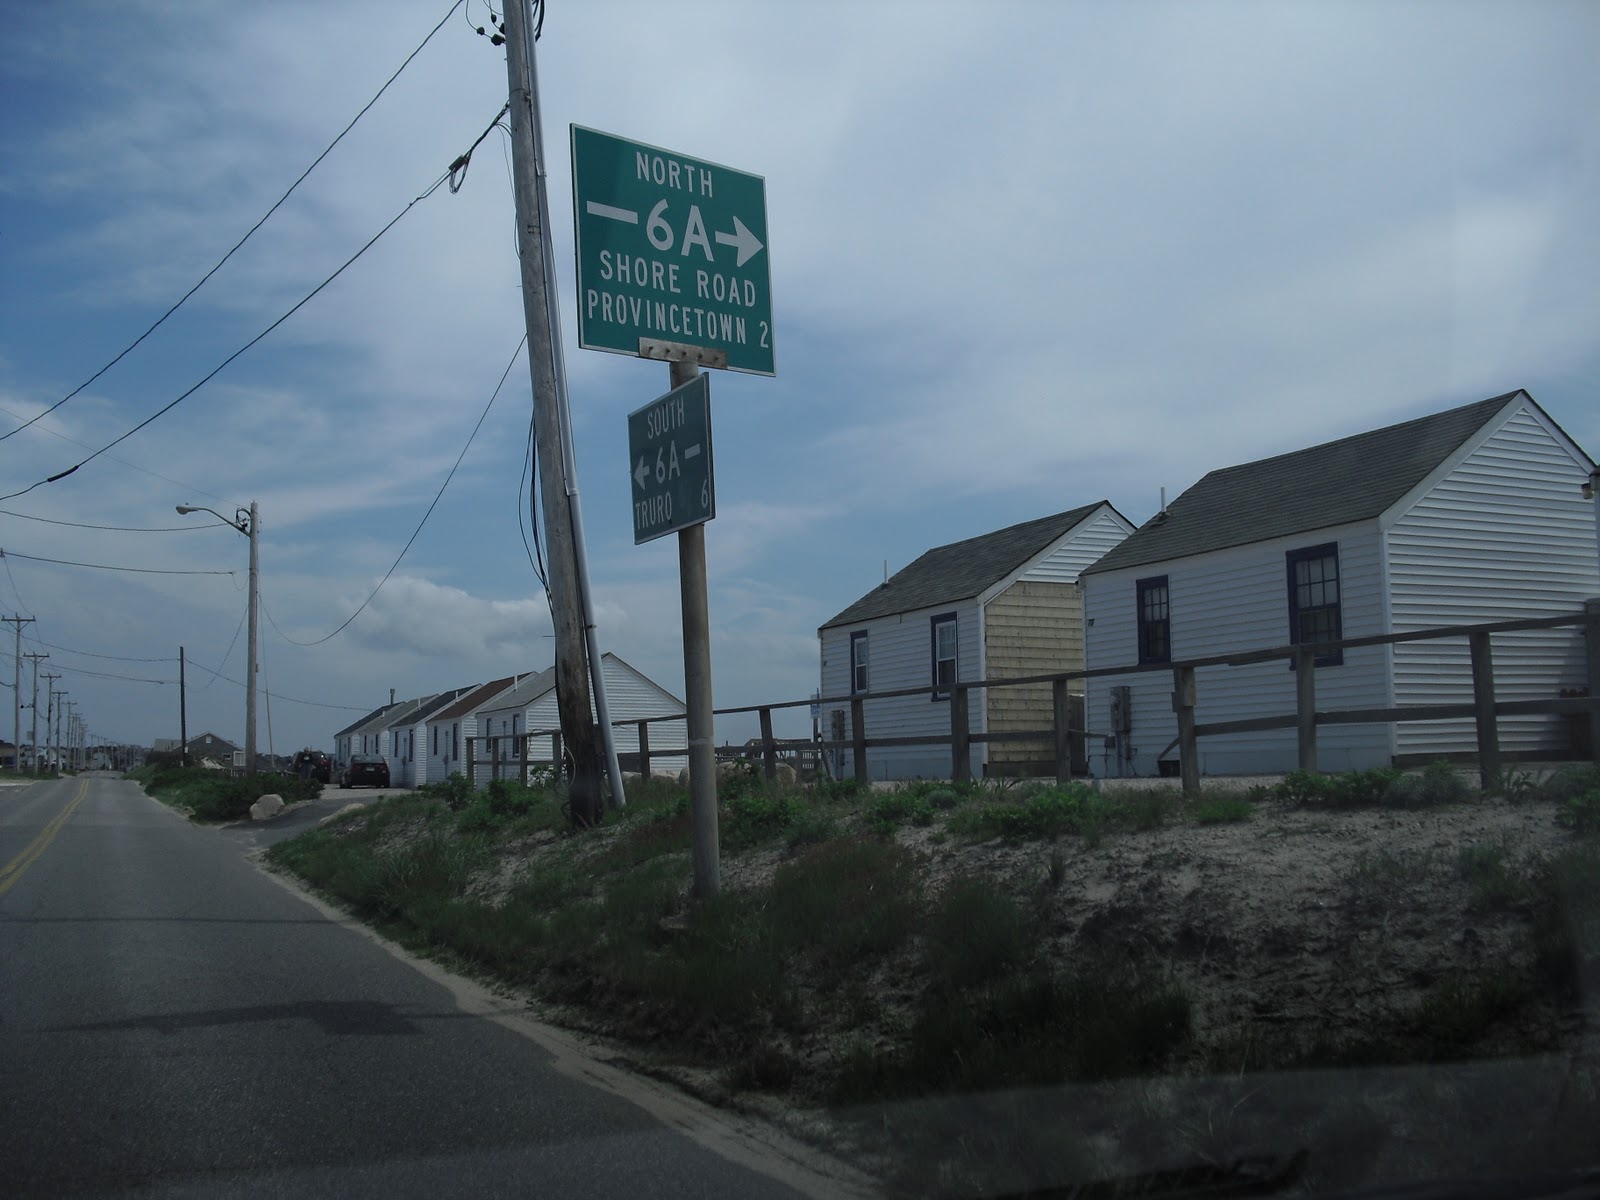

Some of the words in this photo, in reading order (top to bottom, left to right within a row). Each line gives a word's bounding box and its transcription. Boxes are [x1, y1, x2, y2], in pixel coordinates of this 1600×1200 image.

[636, 151, 713, 198] NORTH
[646, 198, 714, 262] 6A
[599, 250, 681, 294] SHORE
[696, 269, 756, 307] ROAD
[587, 289, 746, 344] PROVINCETOWN
[759, 320, 769, 348] 2
[647, 395, 685, 440] SOUTH
[655, 440, 681, 484] 6A
[635, 491, 673, 530] TRURO
[701, 479, 709, 509] 6
